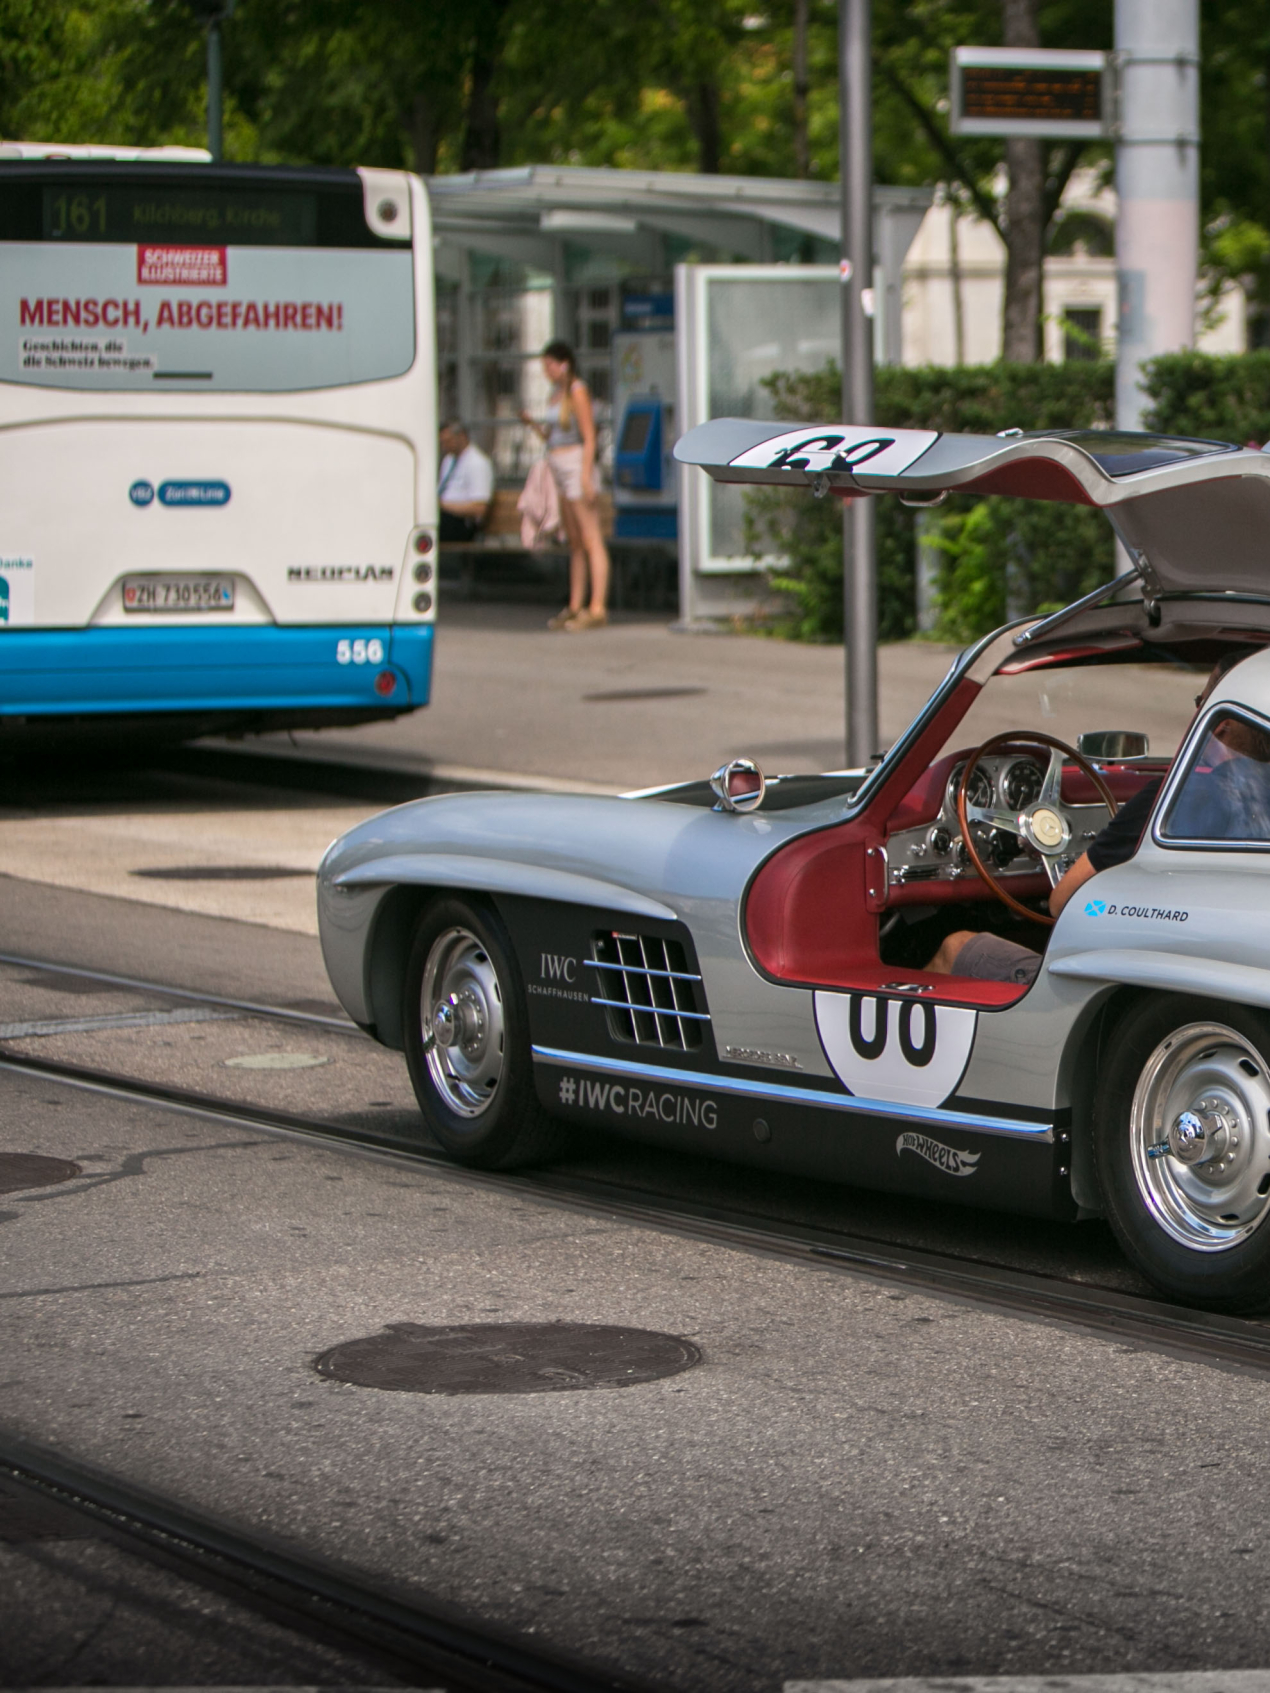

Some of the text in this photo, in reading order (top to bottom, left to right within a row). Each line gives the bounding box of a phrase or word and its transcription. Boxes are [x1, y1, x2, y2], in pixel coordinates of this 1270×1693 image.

[52, 194, 107, 233] 161
[144, 249, 220, 265] SCHWEIZER
[19, 297, 343, 335] MENSCH, ABGEFAHREN!
[104, 338, 123, 353] die
[22, 354, 42, 368] die
[44, 354, 95, 369] Schweiz
[287, 566, 394, 581] NEOPLAN
[336, 638, 384, 665] 556
[1107, 904, 1189, 922] D. COULTHARD
[540, 953, 577, 983] IWC
[527, 984, 589, 1002] SCHAFFHAUSEN
[558, 1076, 719, 1129] #IWCRACING
